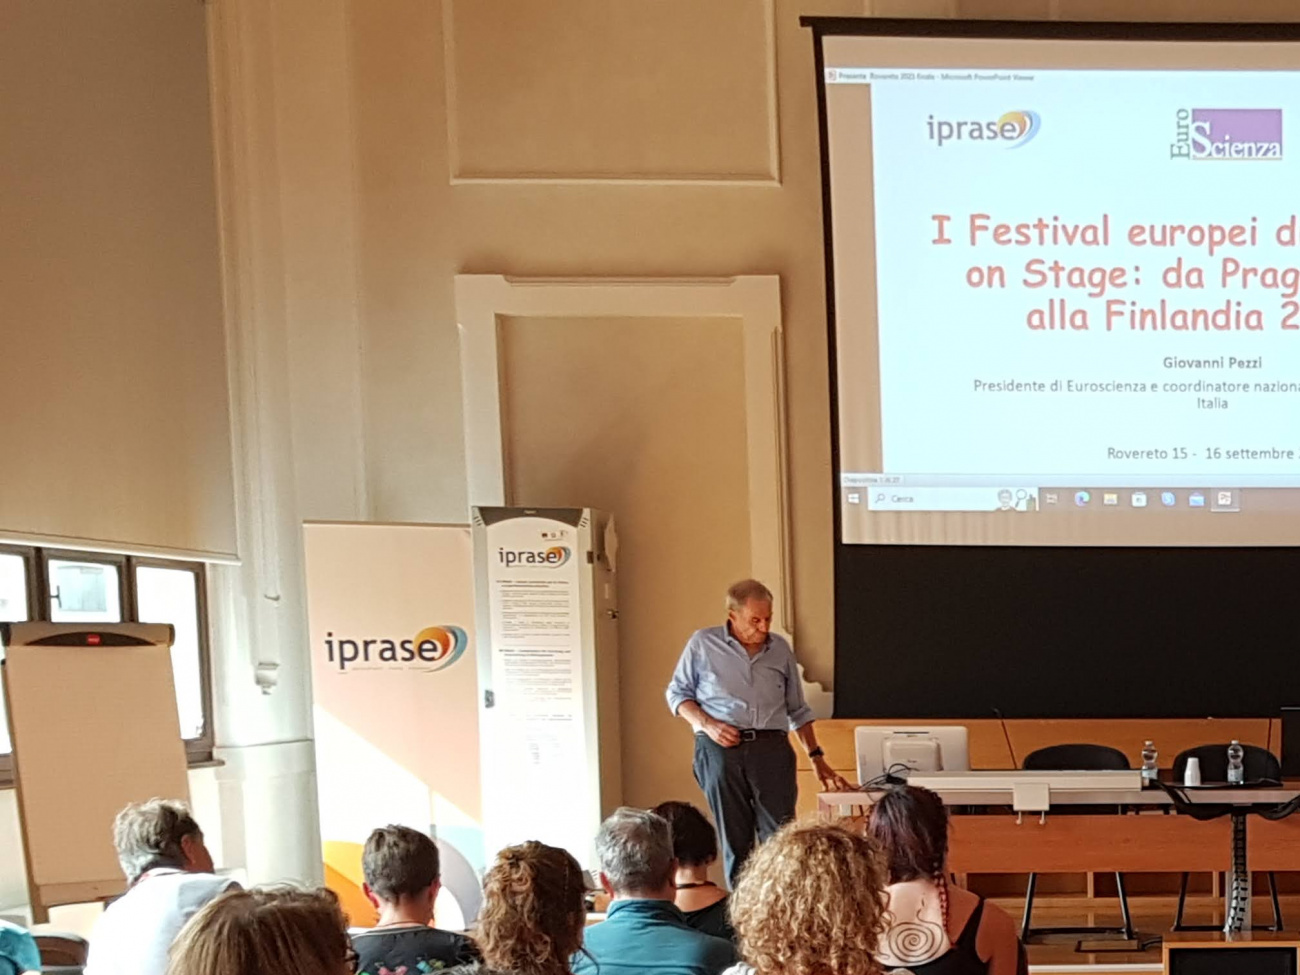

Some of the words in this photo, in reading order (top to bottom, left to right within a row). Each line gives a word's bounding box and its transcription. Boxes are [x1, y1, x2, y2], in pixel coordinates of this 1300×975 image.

[927, 115, 1019, 146] iprase
[1169, 108, 1190, 160] Euro
[1191, 122, 1281, 158] Scienza
[931, 214, 952, 246] I
[969, 213, 1110, 247] Festival
[1127, 215, 1258, 256] europei
[965, 265, 1006, 289] on
[1021, 257, 1142, 298] Stage:
[1162, 257, 1204, 289] da
[1026, 299, 1089, 331] alla
[1105, 299, 1264, 331] Finlandia
[1163, 356, 1224, 369] Giovanni
[1228, 356, 1263, 369] Pezzi
[973, 379, 1046, 393] Presidente
[1050, 379, 1063, 393] di
[1067, 379, 1147, 393] Euroscienza
[1150, 382, 1159, 393] e
[1162, 379, 1250, 393] coordinatore
[1197, 397, 1229, 410] Italia
[1107, 446, 1168, 460] Rovereto
[1172, 446, 1188, 460] 15
[1205, 446, 1222, 460] 16
[1226, 446, 1294, 460] settembre
[498, 547, 558, 568] iprase
[325, 631, 438, 670] iprase
